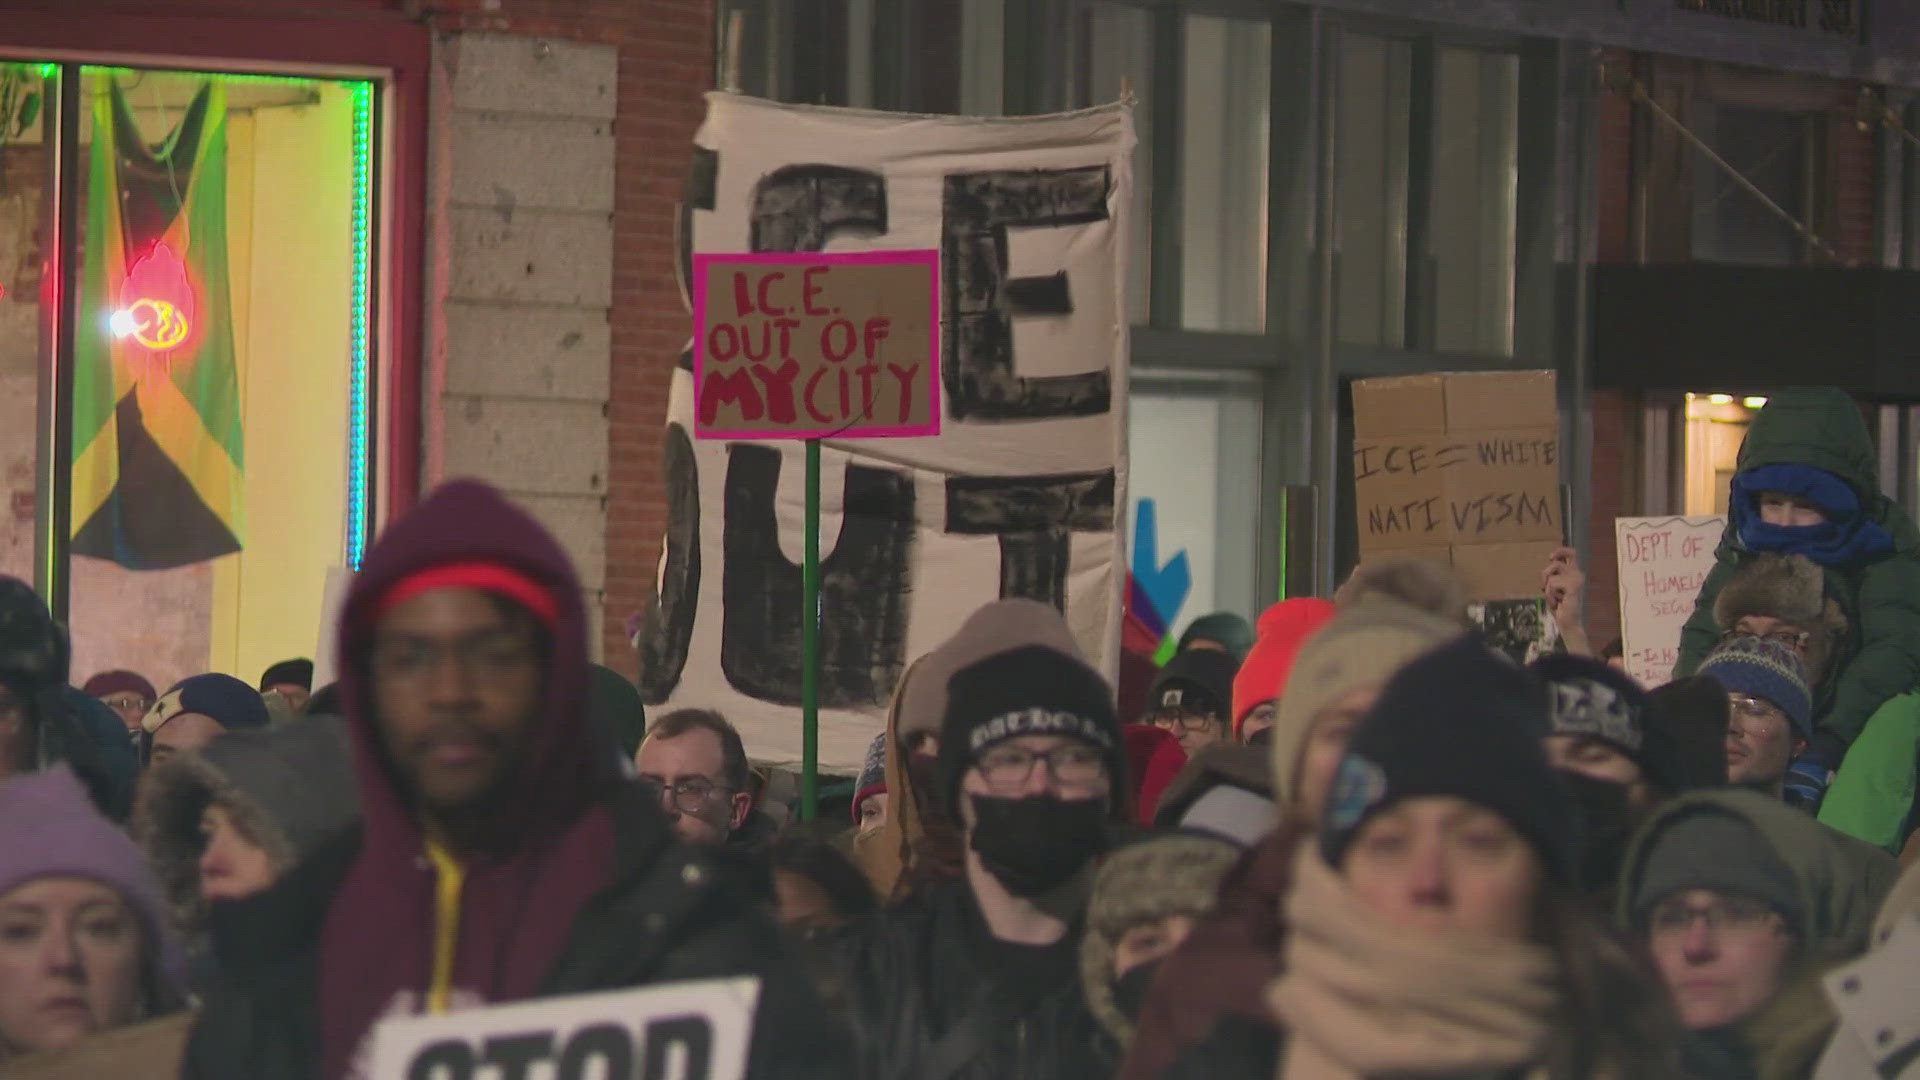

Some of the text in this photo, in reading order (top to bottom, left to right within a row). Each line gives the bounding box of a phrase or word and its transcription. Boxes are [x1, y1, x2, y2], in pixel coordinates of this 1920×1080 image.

[708, 318, 890, 362] OUT OF
[699, 358, 919, 426] MY CITY
[1354, 446, 1429, 480] ICE
[1476, 440, 1556, 465] WHITE
[1682, 536, 1704, 559] OF
